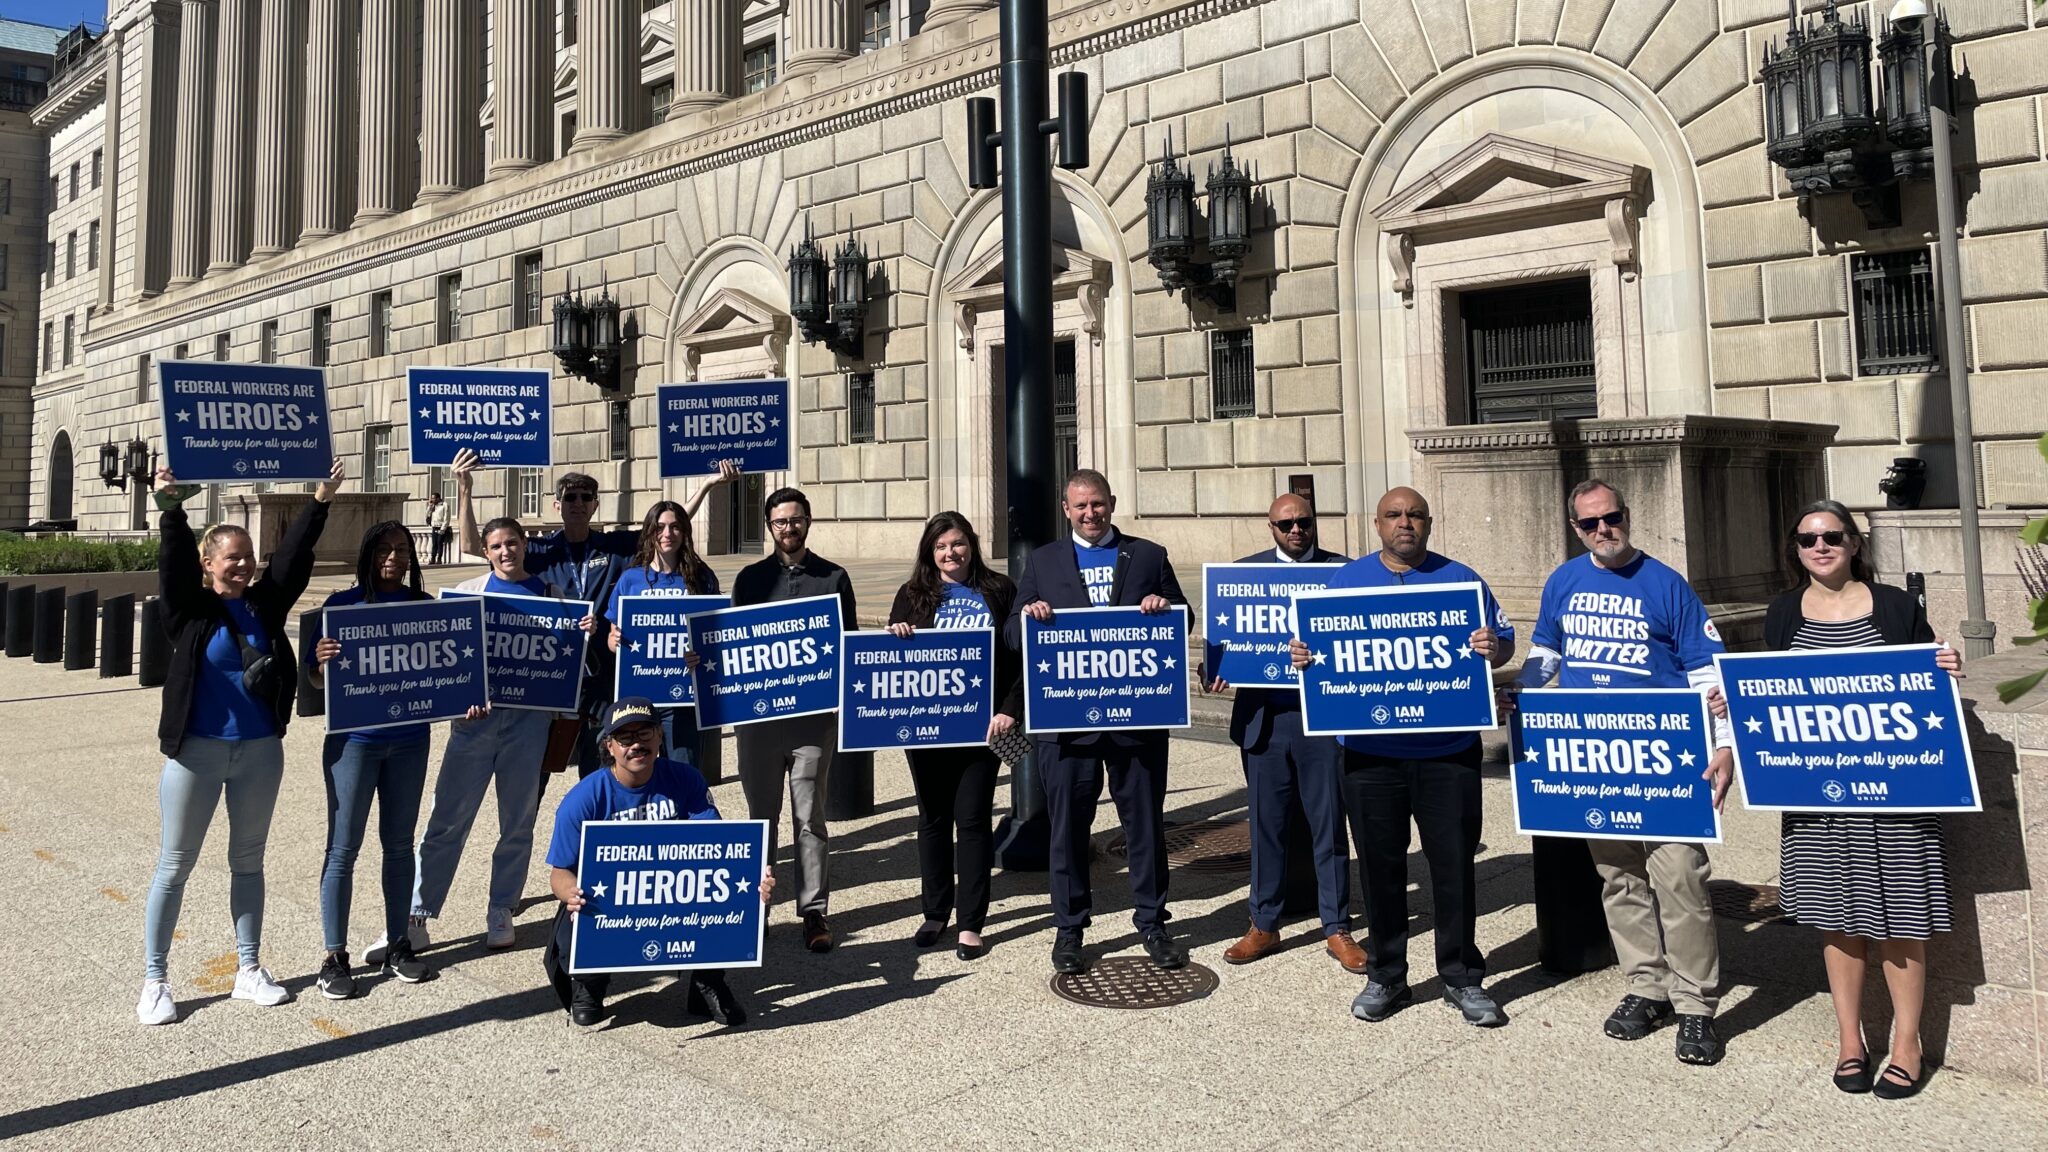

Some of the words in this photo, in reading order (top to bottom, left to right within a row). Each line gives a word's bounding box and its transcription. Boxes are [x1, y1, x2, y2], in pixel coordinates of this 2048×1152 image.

[709, 18, 978, 125] DEPARTMENT
[174, 379, 230, 394] FEDERAL
[231, 381, 290, 397] WORKERS
[293, 384, 316, 397] ARE
[419, 383, 464, 395] FEDERAL
[466, 384, 517, 396] WORKERS
[519, 385, 540, 397] ARE
[668, 398, 710, 411] FEDERAL
[711, 395, 759, 408] WORKERS
[760, 394, 779, 406] ARE
[197, 401, 303, 431] HEROES
[436, 401, 525, 426] HEROES
[684, 411, 766, 438] HEROES
[182, 436, 220, 449] Thank
[221, 440, 244, 451] you
[244, 438, 264, 451] for
[264, 437, 280, 448] all
[280, 440, 302, 451] you
[302, 437, 318, 448] do!
[423, 429, 453, 439] Thank
[454, 432, 473, 442] you
[473, 431, 489, 442] for
[490, 431, 503, 440] all
[504, 433, 523, 443] you
[523, 431, 538, 441] do!
[671, 442, 700, 453] Thank
[700, 443, 718, 453] you
[717, 441, 733, 452] for
[733, 440, 746, 449] all
[746, 441, 763, 450] you
[763, 437, 777, 447] do!
[480, 449, 501, 458] IAM
[727, 457, 744, 466] AM
[254, 460, 280, 470] IAM
[1217, 583, 1267, 597] FEDERAL
[949, 599, 983, 610] BETTER
[1568, 592, 1644, 618] FEDERAL
[338, 624, 390, 641] FEDERAL
[392, 619, 448, 636] WORKERS
[450, 617, 472, 632] ARE
[499, 612, 553, 629] WORKERS
[554, 617, 578, 631] ARE
[631, 614, 677, 626] FEDERAL
[934, 613, 993, 629] nion
[1310, 615, 1368, 633] FEDERAL
[1369, 611, 1437, 629] WORKERS
[1440, 609, 1468, 626] ARE
[1562, 614, 1649, 641] WORKERS
[702, 626, 750, 645] FEDERAL
[751, 618, 806, 638] WORKERS
[808, 614, 830, 630] ARE
[1037, 629, 1088, 644] FEDERAL
[1090, 627, 1148, 642] WORKERS
[1151, 626, 1174, 640] ARE
[486, 631, 558, 662] EROES
[647, 633, 690, 658] HER
[1220, 639, 1254, 652] Thank
[1255, 643, 1276, 655] you
[1333, 635, 1452, 673] HEROES
[1565, 637, 1650, 664] MATTER
[358, 639, 458, 676] HEROES
[721, 637, 818, 676] HEROES
[854, 650, 902, 665] FEDERAL
[904, 648, 958, 663] WORKERS
[960, 647, 982, 661] ARE
[1057, 648, 1158, 679] HEROES
[497, 665, 515, 677] for
[515, 666, 530, 677] all
[530, 670, 550, 680] you
[550, 669, 567, 680] do!
[632, 665, 663, 676] Thank
[663, 667, 683, 678] you
[1592, 674, 1611, 682] IAM
[343, 682, 378, 697] Thank
[378, 683, 400, 696] you
[400, 680, 419, 693] for
[419, 676, 434, 688] all
[435, 677, 455, 690] you
[455, 672, 472, 684] do!
[501, 686, 525, 696] IAM
[710, 682, 743, 696] Thank
[743, 681, 763, 694] you
[764, 678, 781, 691] for
[782, 674, 796, 685] all
[797, 673, 817, 686] you
[817, 668, 833, 680] do!
[871, 668, 966, 699] HEROES
[1319, 681, 1358, 695] Thank
[1359, 683, 1383, 697] you
[1384, 680, 1406, 695] for
[1406, 678, 1425, 691] all
[1425, 680, 1451, 695] you
[1451, 676, 1471, 690] do!
[1738, 677, 1808, 697] FEDERAL
[1809, 674, 1895, 694] WORKERS
[1900, 672, 1936, 691] ARE
[1042, 686, 1076, 699] Thank
[1077, 688, 1098, 700] you
[1098, 686, 1117, 699] for
[1118, 684, 1133, 696] all
[1134, 686, 1155, 699] you
[1156, 683, 1173, 695] do!
[408, 699, 433, 711] IAM
[772, 696, 796, 708] IAM
[856, 706, 888, 718] Thank
[889, 708, 909, 719] you
[909, 705, 927, 718] for
[927, 703, 942, 714] all
[942, 705, 962, 717] you
[962, 701, 979, 713] do!
[1106, 708, 1131, 718] IAM
[1395, 705, 1424, 718] IAM
[1521, 713, 1582, 729] FEDERAL
[1584, 713, 1656, 730] WORKERS
[1660, 713, 1691, 730] ARE
[1768, 702, 1918, 742] HEROES
[916, 726, 939, 736] IAM
[1546, 738, 1672, 775] HEROES
[1756, 751, 1803, 767] Thank
[1804, 755, 1834, 770] you
[1836, 752, 1862, 769] for
[1863, 751, 1885, 766] all
[1887, 754, 1919, 770] you
[1919, 750, 1944, 766] do!
[1531, 779, 1572, 794] Thank
[1573, 785, 1598, 798] you
[1599, 783, 1622, 799] for
[1623, 783, 1643, 797] all
[1643, 787, 1671, 801] you
[1672, 784, 1693, 799] do!
[1851, 782, 1888, 795] IAM
[1610, 811, 1642, 824] IAM
[596, 845, 654, 862] FEDERAL
[658, 843, 722, 860] WORKERS
[724, 843, 751, 859] ARE
[614, 868, 730, 906] HEROES
[594, 914, 634, 930] Thank
[634, 917, 660, 931] you
[659, 914, 682, 930] for
[682, 912, 700, 926] all
[700, 914, 725, 929] you
[725, 910, 745, 924] do!
[666, 940, 695, 953] IAM
